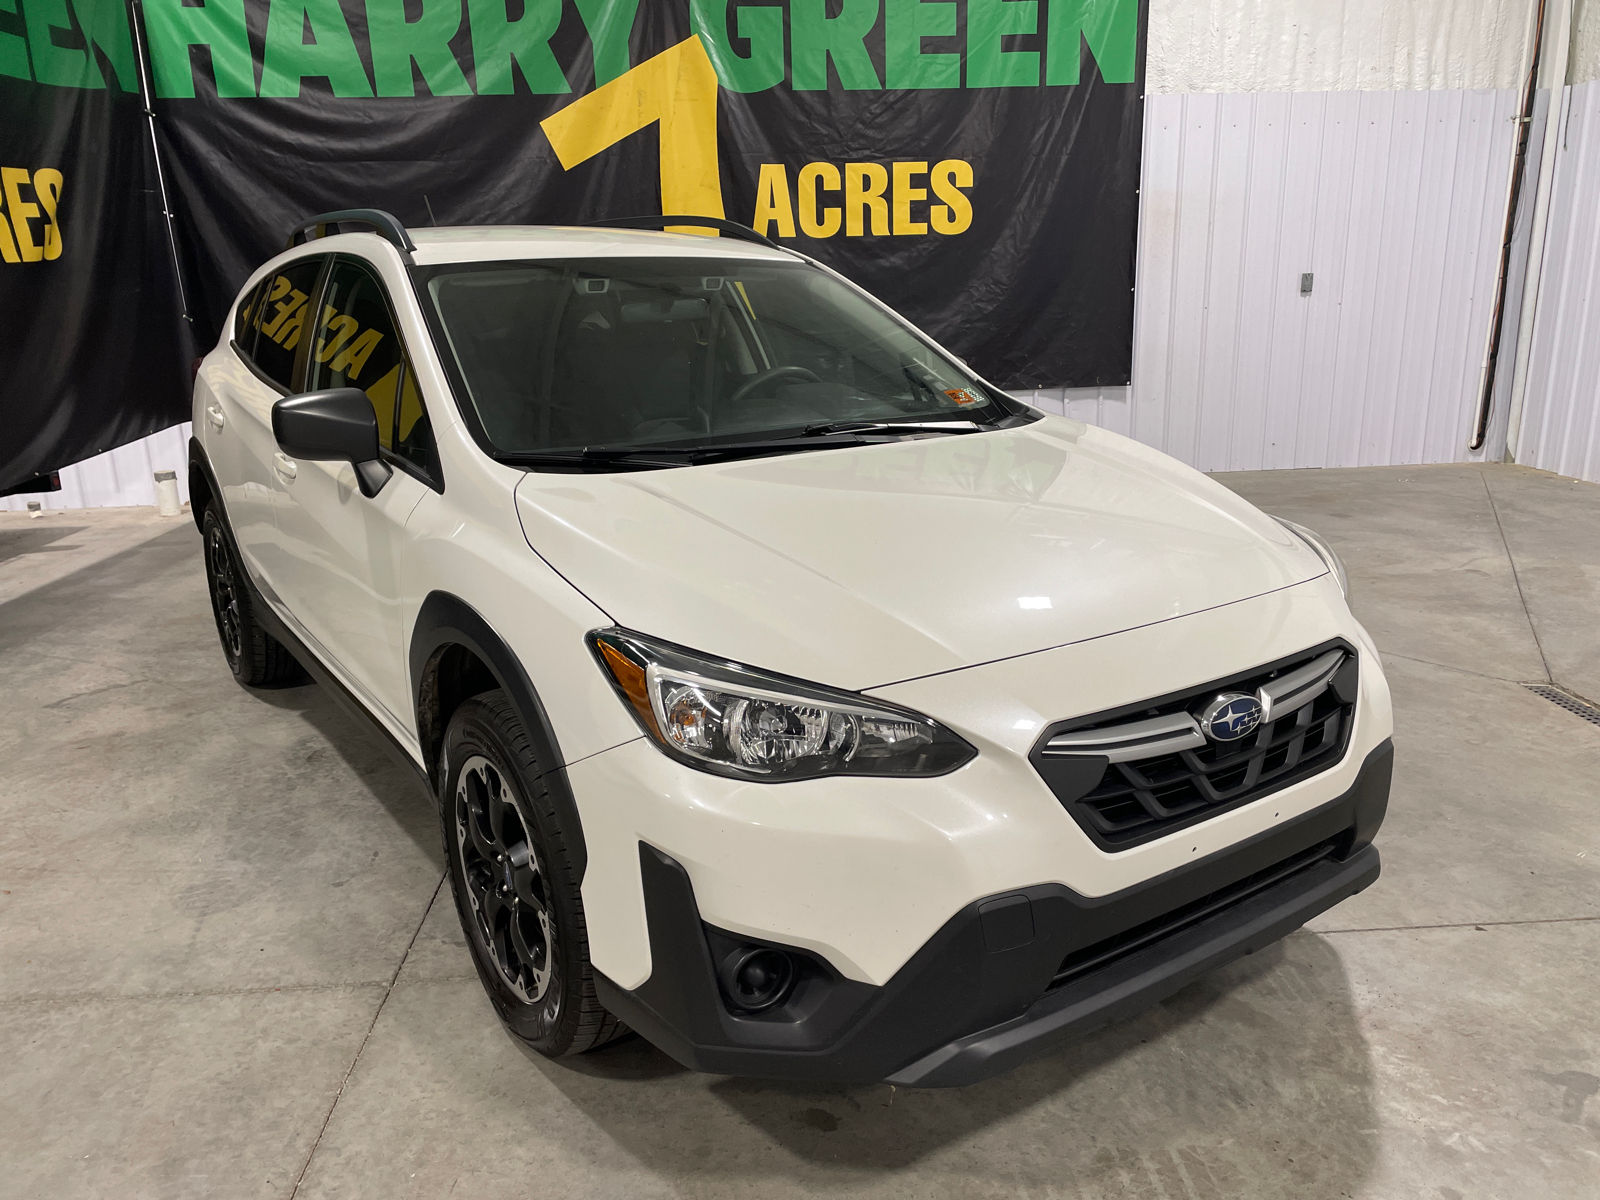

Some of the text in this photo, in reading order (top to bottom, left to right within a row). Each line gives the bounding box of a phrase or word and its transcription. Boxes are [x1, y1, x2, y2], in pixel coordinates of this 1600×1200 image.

[690, 0, 1138, 93] GREEN
[0, 166, 63, 263] ES
[752, 159, 975, 239] ACRES
